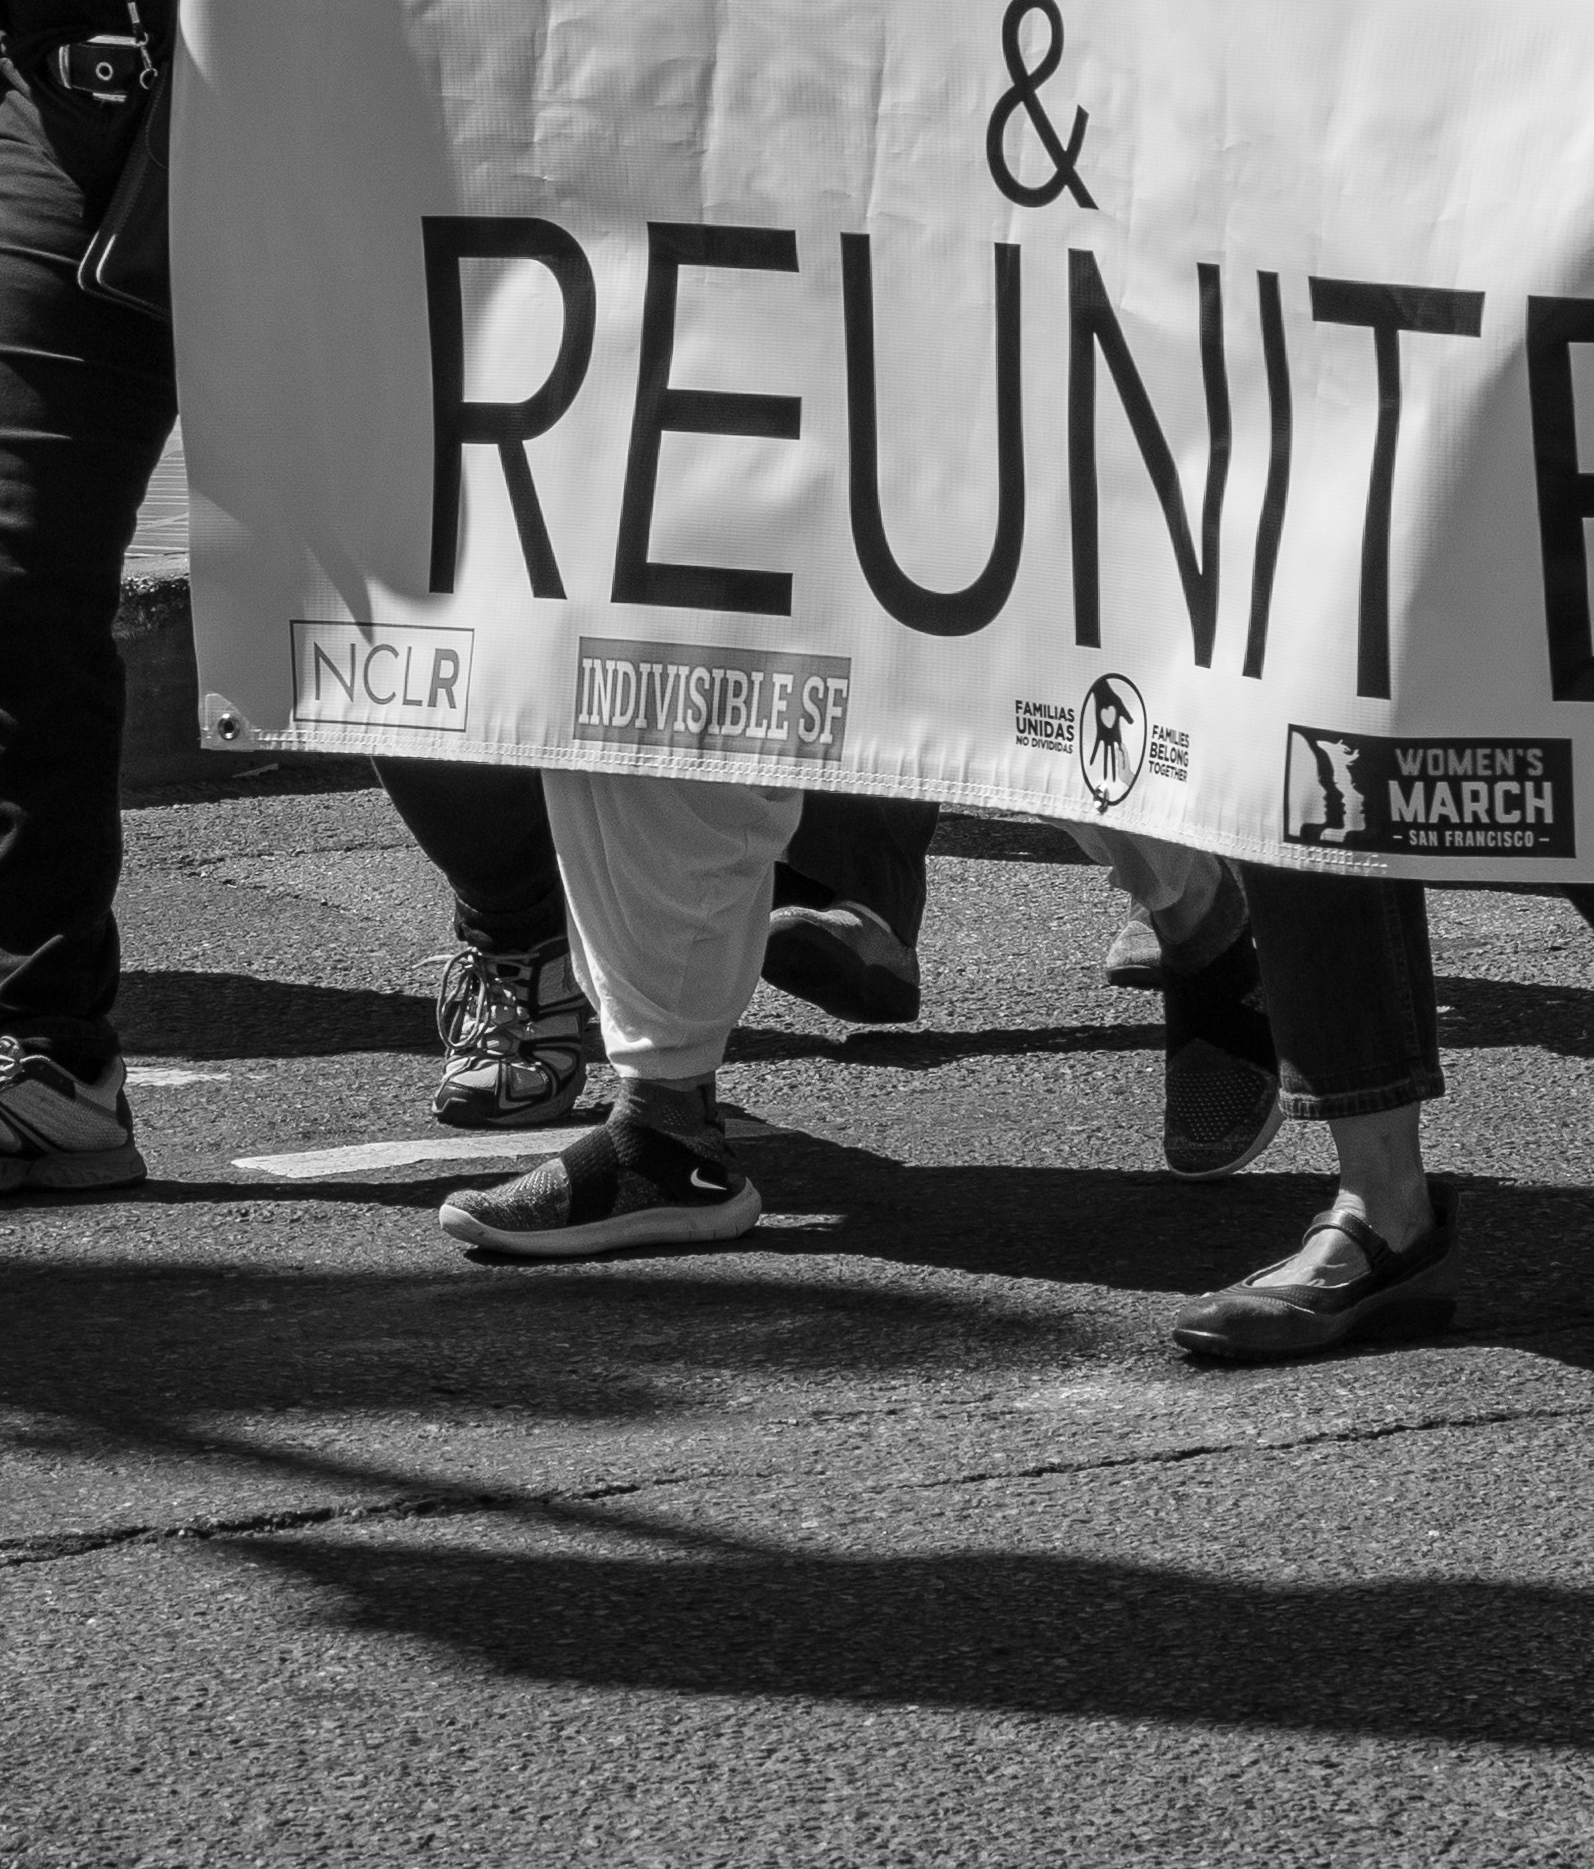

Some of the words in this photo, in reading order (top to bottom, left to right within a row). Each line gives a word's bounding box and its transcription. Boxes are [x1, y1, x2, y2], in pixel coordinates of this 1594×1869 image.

[313, 641, 461, 709] NCLR
[577, 657, 795, 742] INDIVISIBLE
[798, 675, 850, 745] SF
[1015, 699, 1076, 723] FAMILIAS
[1015, 716, 1076, 743] UNIDAS
[1152, 724, 1190, 748] FAMILIES
[1015, 735, 1030, 747] NO
[1030, 737, 1074, 755] DIVIDIDAS
[1149, 741, 1190, 768] BELONG
[1148, 759, 1188, 783] TOGETHER
[1394, 748, 1544, 777] WOMEN'S
[1388, 779, 1554, 824] MARCH
[1409, 829, 1438, 848] SAN
[1444, 829, 1535, 848] FRANCISCO
